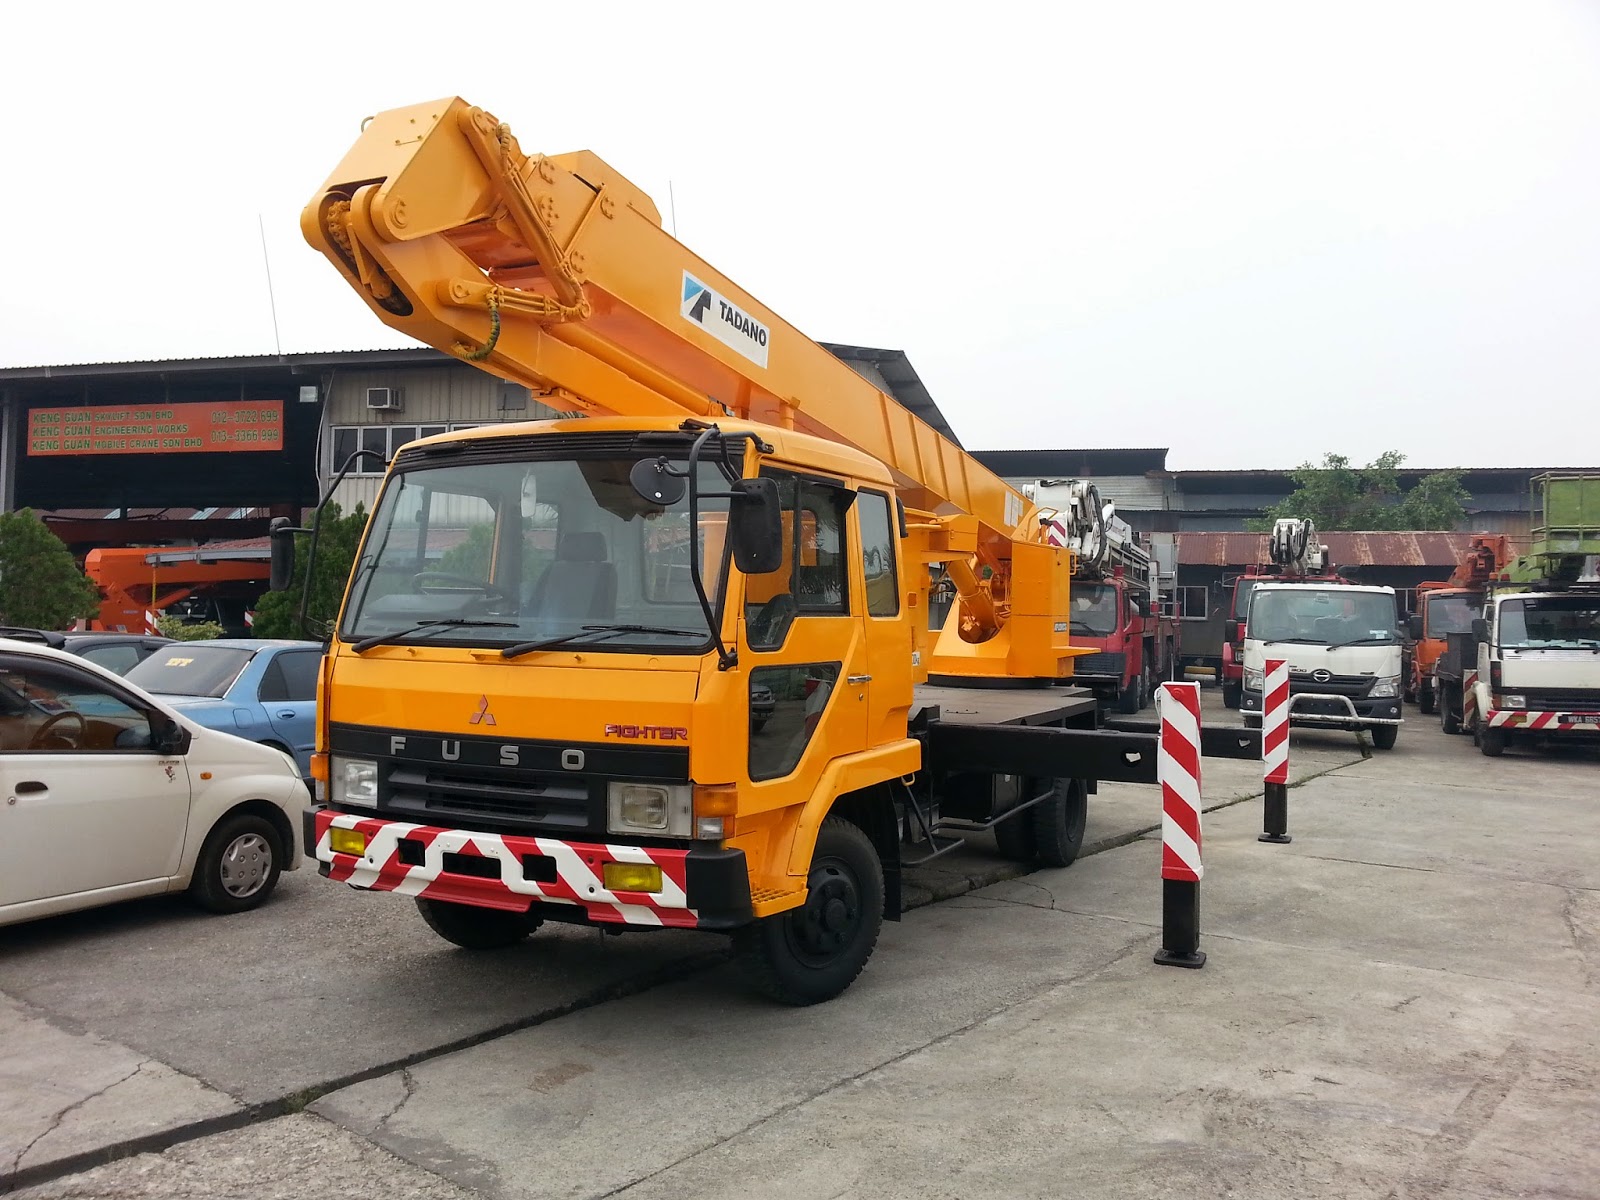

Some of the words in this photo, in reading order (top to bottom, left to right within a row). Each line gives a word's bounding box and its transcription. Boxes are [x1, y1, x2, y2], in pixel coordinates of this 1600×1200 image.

[719, 300, 767, 347] TADANO
[33, 412, 60, 423] KENG
[64, 412, 91, 422] GUAN
[95, 411, 130, 421] SKYLIFT
[134, 411, 152, 421] SDN
[155, 410, 174, 419] BHD
[32, 426, 60, 437] KENG
[63, 425, 91, 436] GUAN
[94, 425, 153, 436] ENGINEERING
[156, 424, 188, 434] WORKS
[31, 440, 59, 451] KENG
[63, 439, 91, 450] GUAN
[94, 439, 126, 449] MOBILE
[129, 439, 159, 449] CRANE
[162, 438, 180, 448] SDN
[183, 438, 203, 447] BHD
[604, 723, 688, 740] FIGHTER
[389, 735, 586, 771] FUSO
